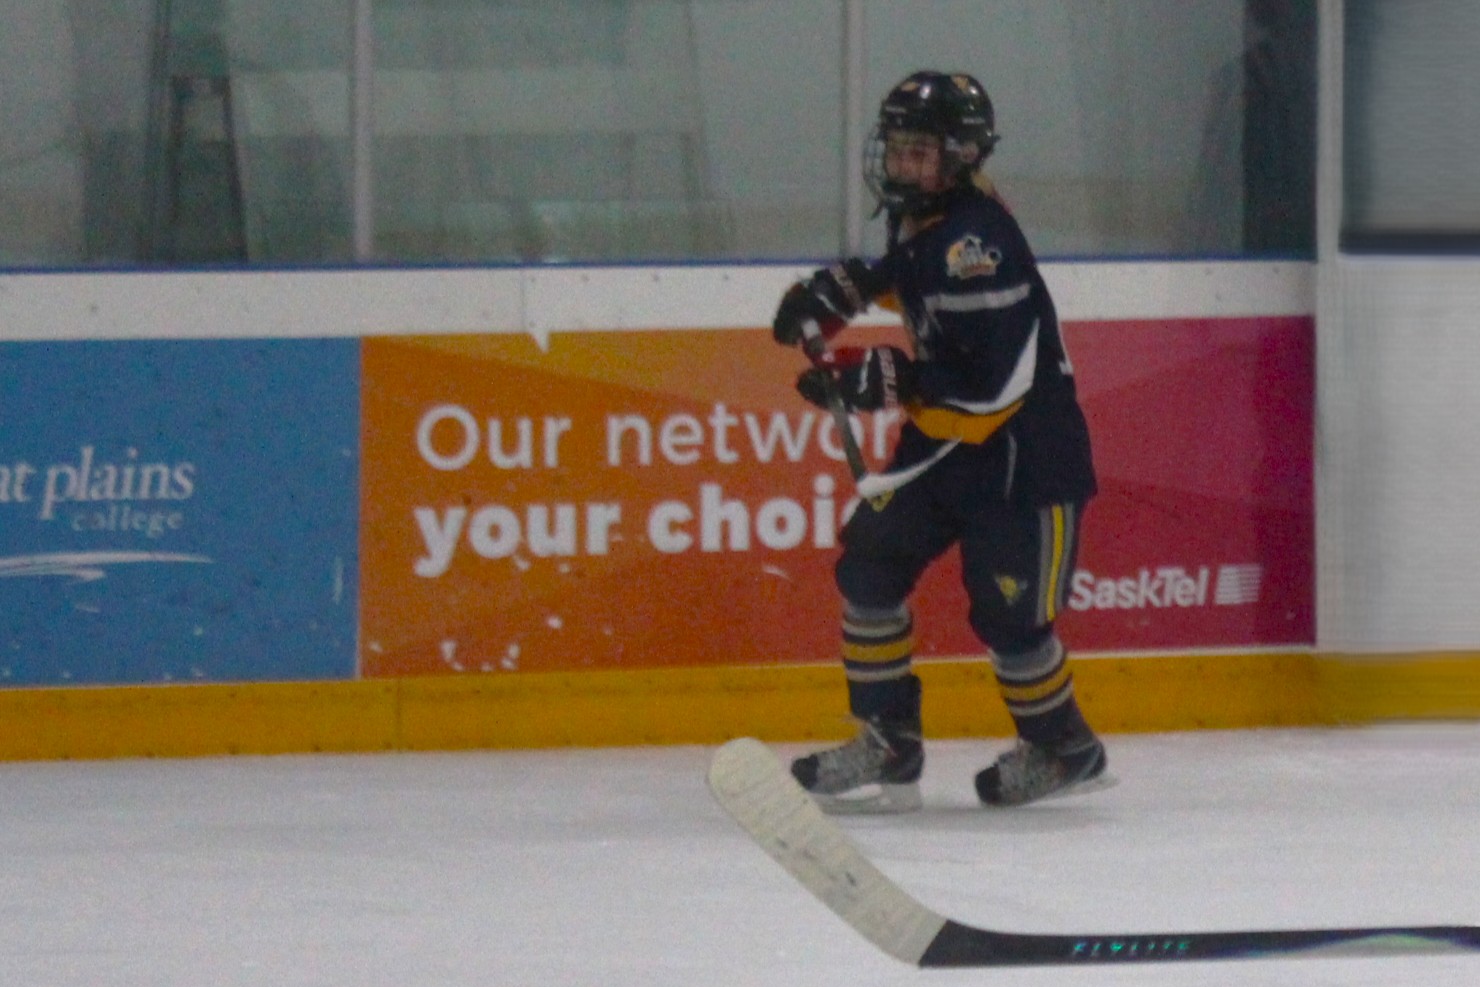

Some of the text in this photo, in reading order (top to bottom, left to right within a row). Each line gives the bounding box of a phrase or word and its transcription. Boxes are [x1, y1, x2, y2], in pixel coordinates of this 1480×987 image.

[416, 403, 901, 471] Our networ
[39, 446, 196, 521] plains
[71, 502, 185, 538] college
[413, 473, 863, 578] your choi
[1068, 565, 1211, 612] SaskTel
